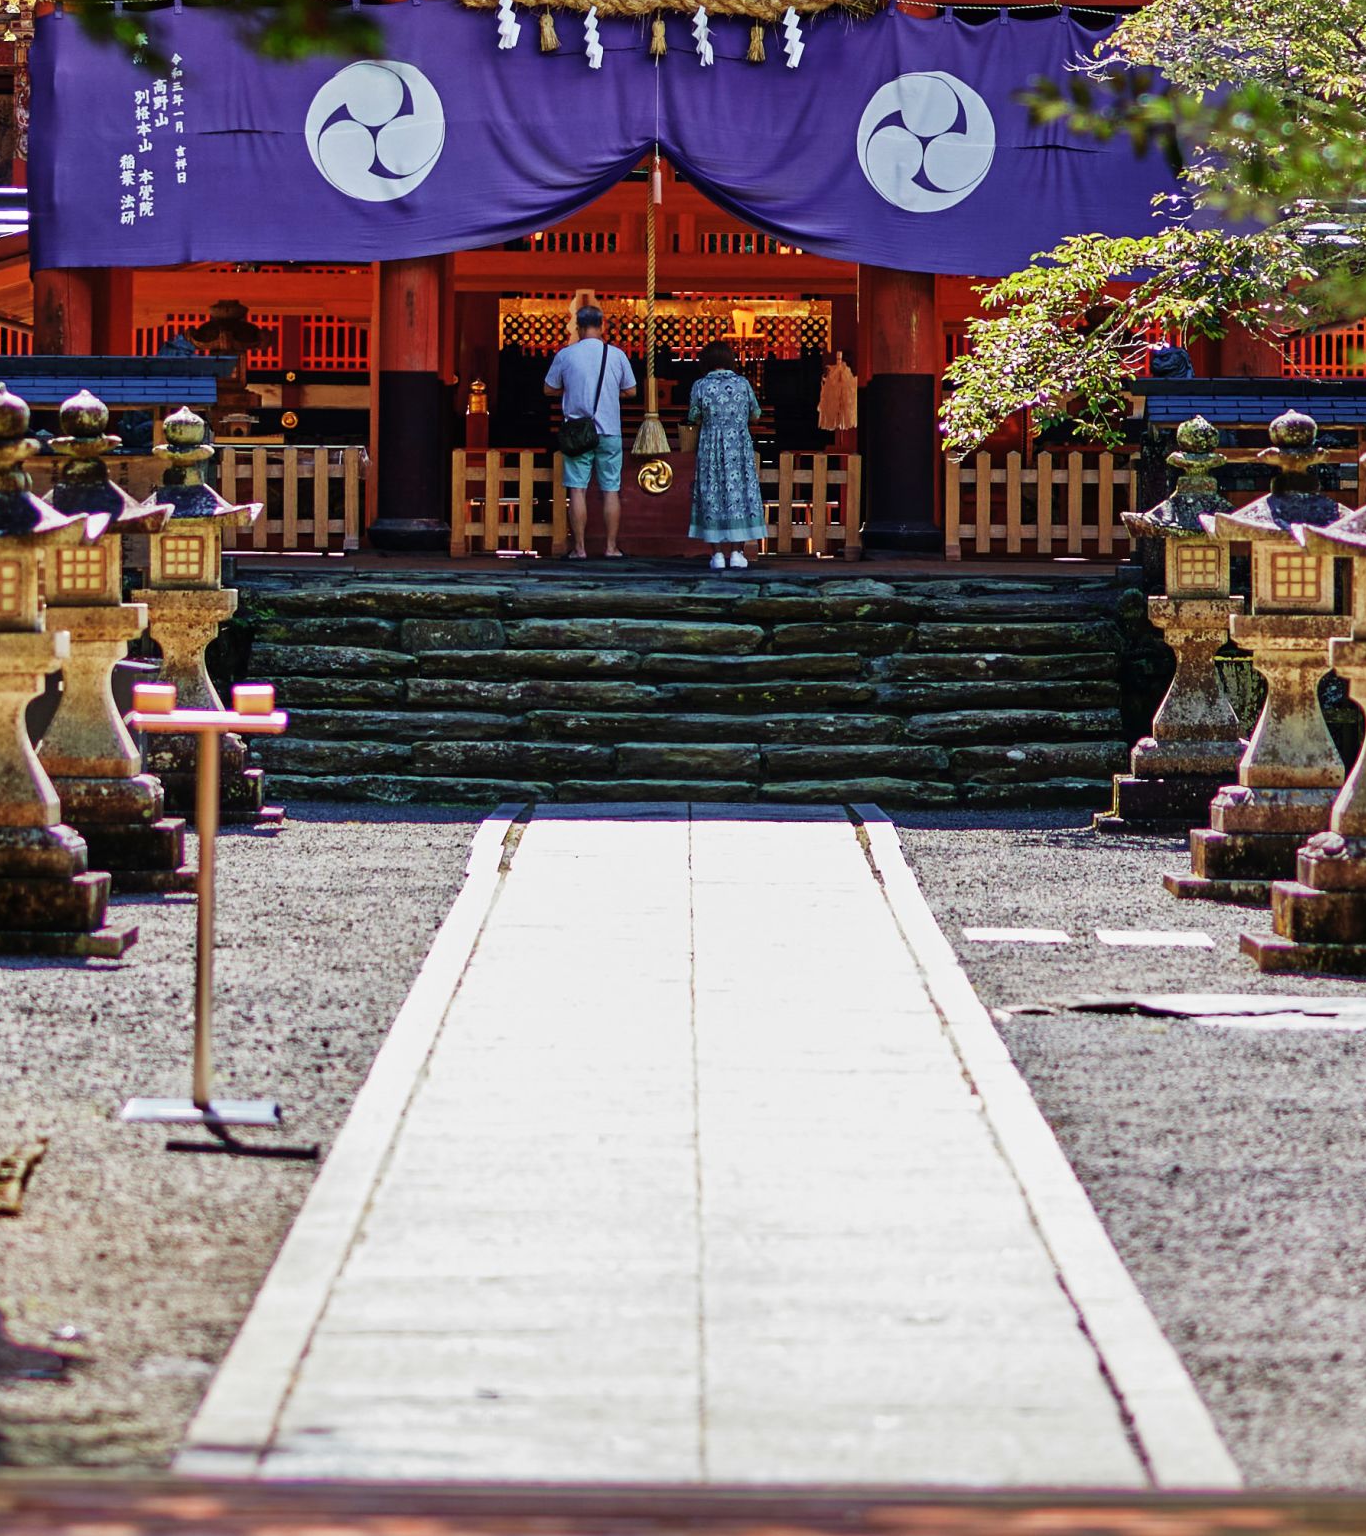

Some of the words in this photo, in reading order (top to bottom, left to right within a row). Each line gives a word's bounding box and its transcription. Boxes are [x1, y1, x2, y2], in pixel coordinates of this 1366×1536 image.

[134, 88, 153, 153] 別格本山
[152, 78, 169, 128] 高野山
[175, 144, 188, 184] 吉祥日
